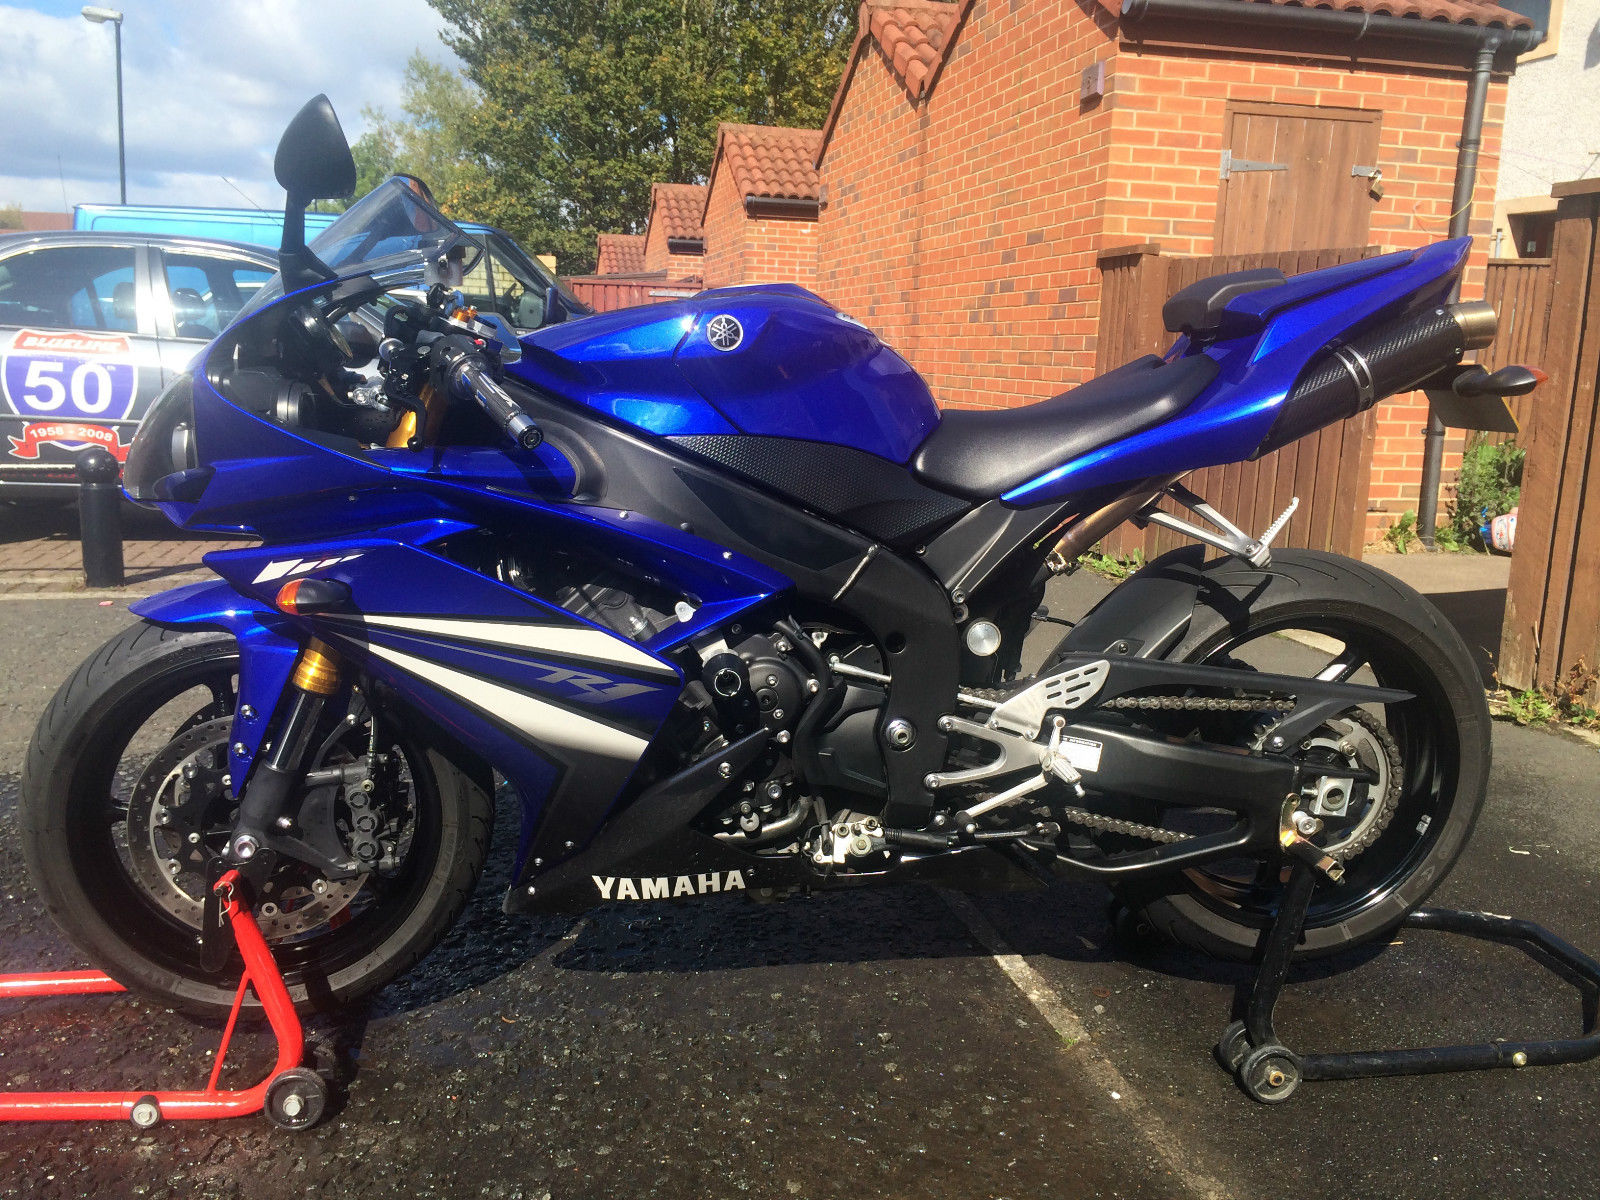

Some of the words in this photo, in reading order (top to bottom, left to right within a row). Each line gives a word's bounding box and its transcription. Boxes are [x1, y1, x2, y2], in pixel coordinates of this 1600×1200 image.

[30, 426, 65, 438] 1958
[77, 427, 113, 442] 2008
[591, 869, 746, 900] YAMAHA
